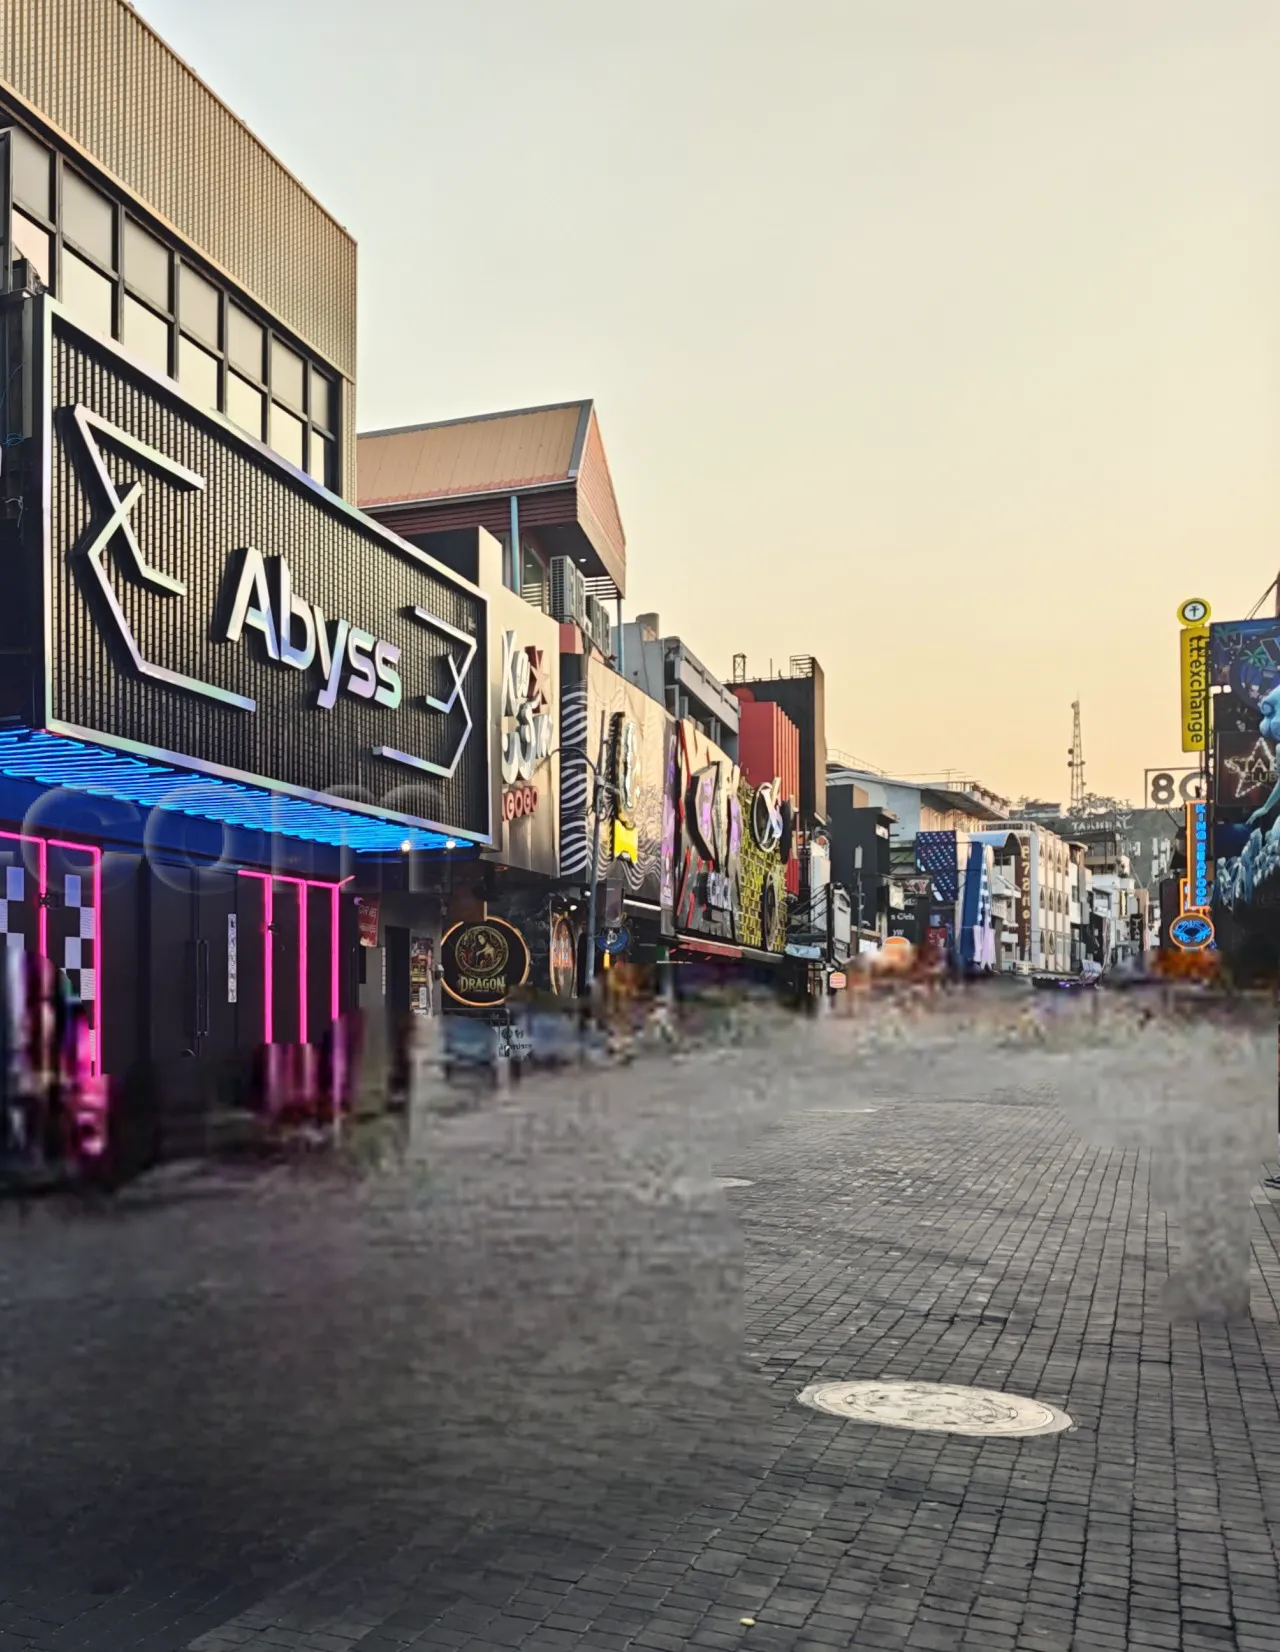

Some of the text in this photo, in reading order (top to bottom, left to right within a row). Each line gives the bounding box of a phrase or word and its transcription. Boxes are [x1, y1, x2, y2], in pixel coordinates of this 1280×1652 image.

[225, 546, 403, 710] Abyss
[1195, 803, 1207, 906] KING SEAFOOD
[460, 975, 506, 994] DRAGON
